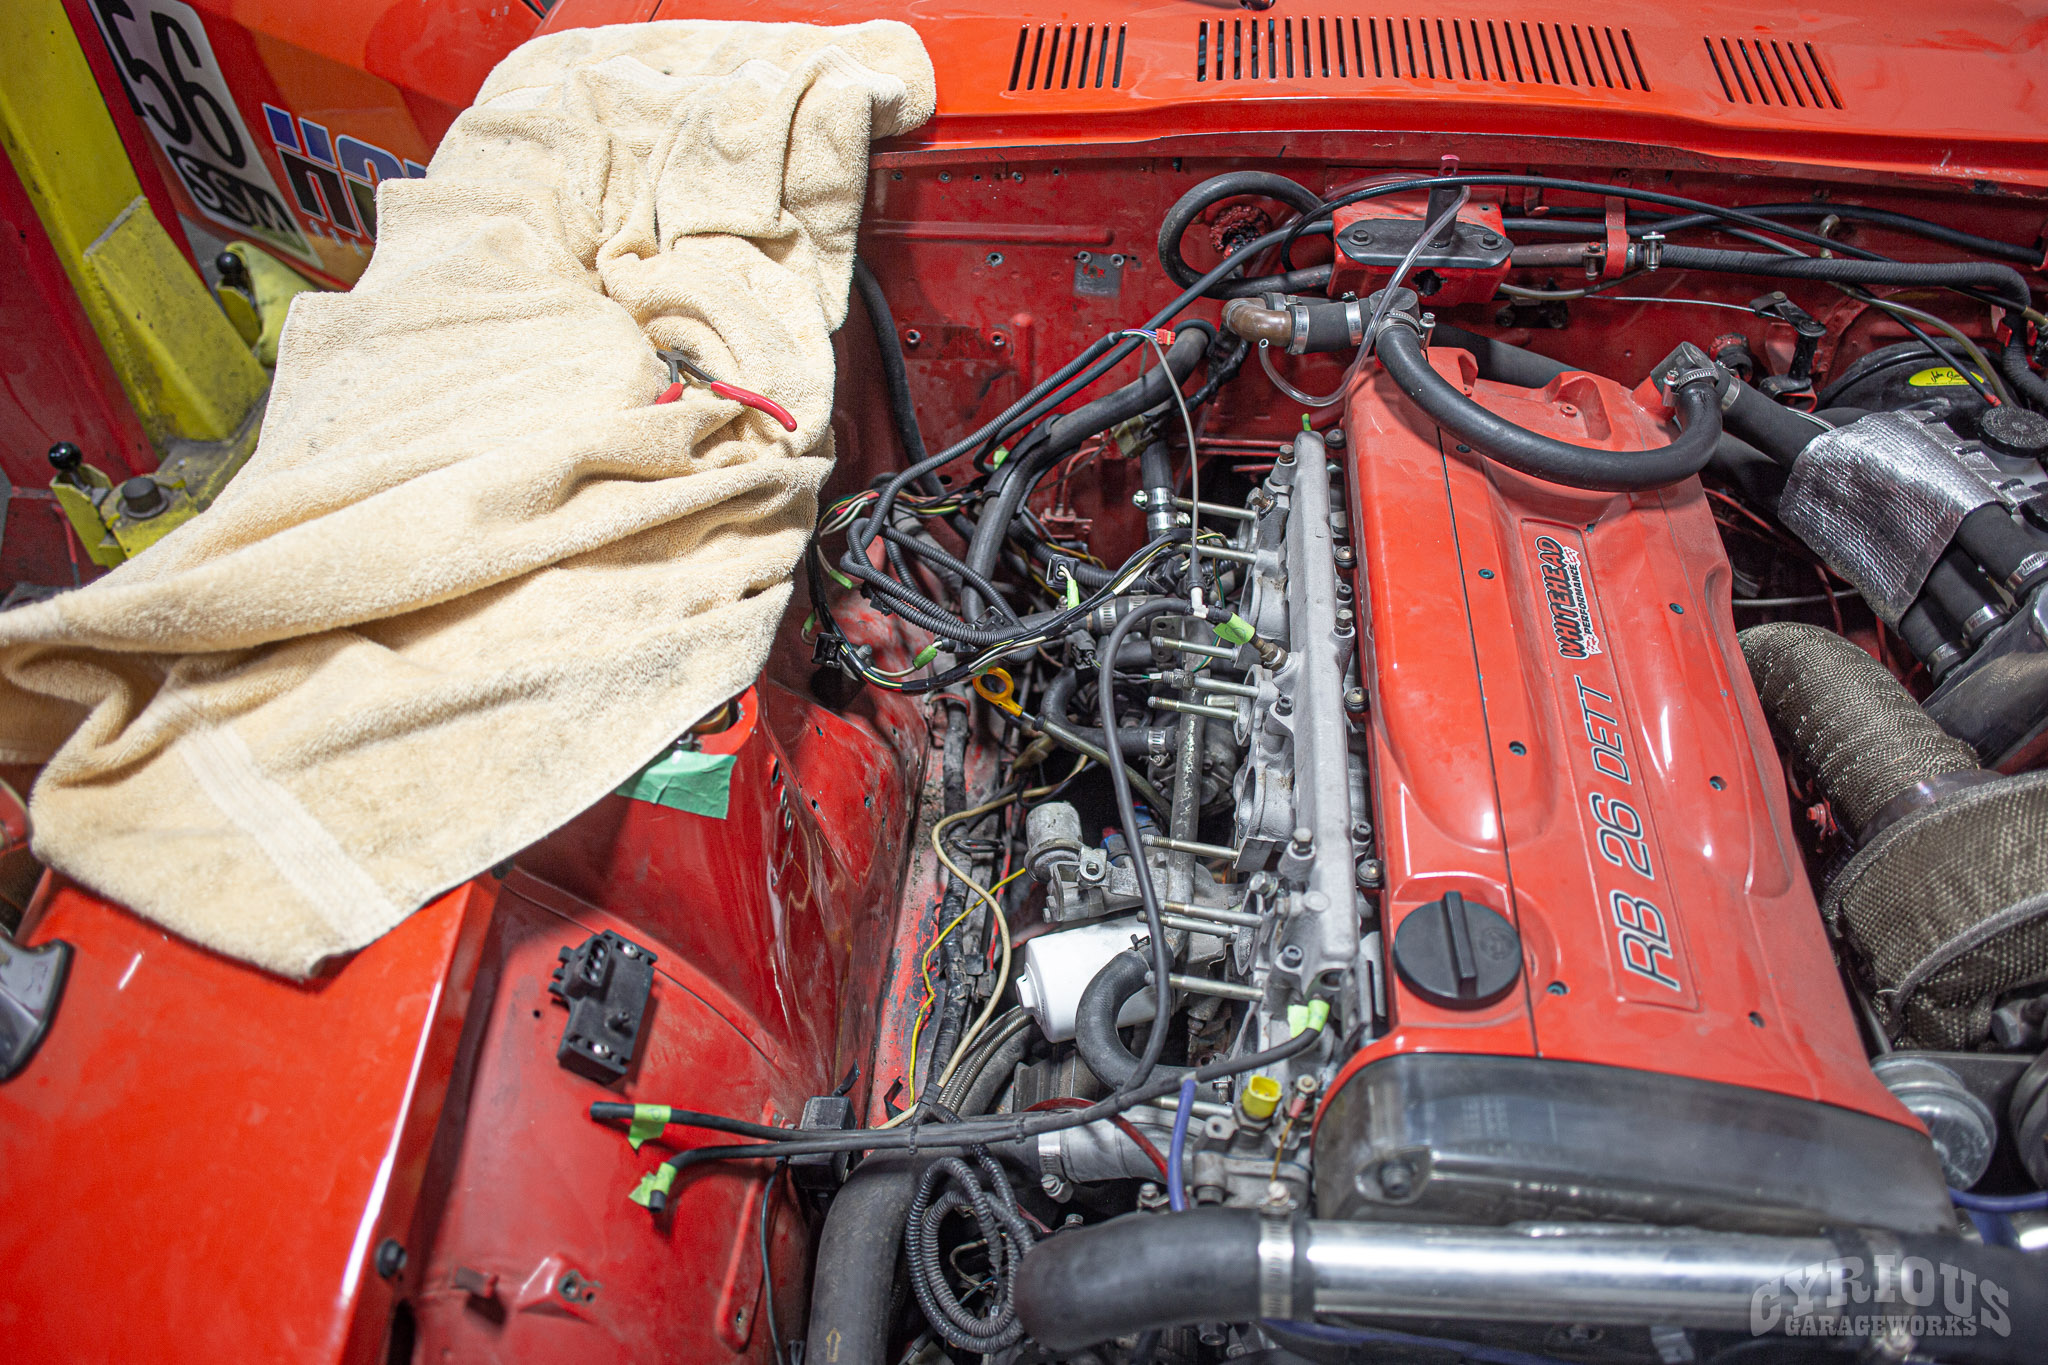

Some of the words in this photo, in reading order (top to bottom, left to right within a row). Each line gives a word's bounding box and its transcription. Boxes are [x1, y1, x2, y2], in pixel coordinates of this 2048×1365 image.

[1537, 537, 1587, 658] WHITEHEAD
[1569, 564, 1593, 634] PERFORMANCE
[1574, 674, 1632, 784] DETT
[1589, 791, 1655, 881] 26
[1609, 888, 1681, 992] RB
